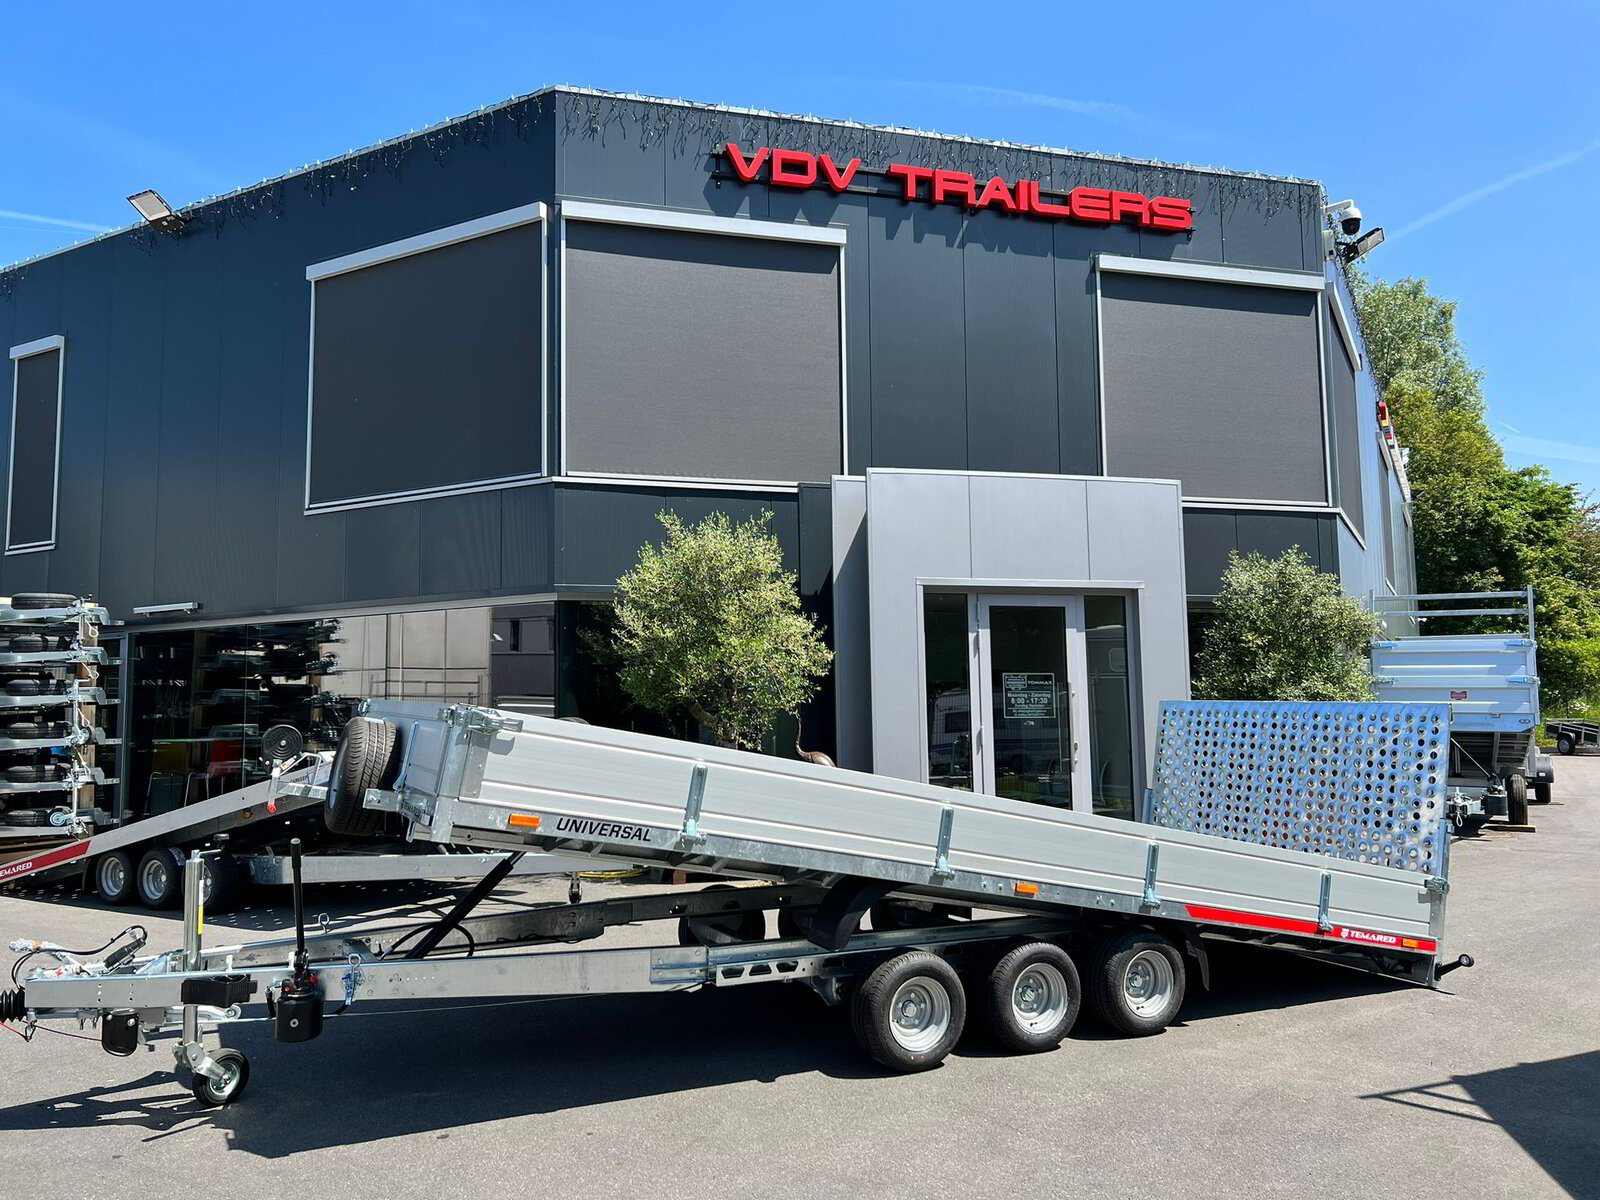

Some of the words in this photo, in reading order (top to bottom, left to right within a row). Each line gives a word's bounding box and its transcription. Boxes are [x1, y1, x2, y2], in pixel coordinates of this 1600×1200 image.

[726, 143, 860, 192] VDV
[888, 163, 1193, 231] TRAILERS
[556, 817, 651, 842] UNIVERSAL
[0, 861, 32, 877] EMARED
[1350, 930, 1396, 943] TEMARED
